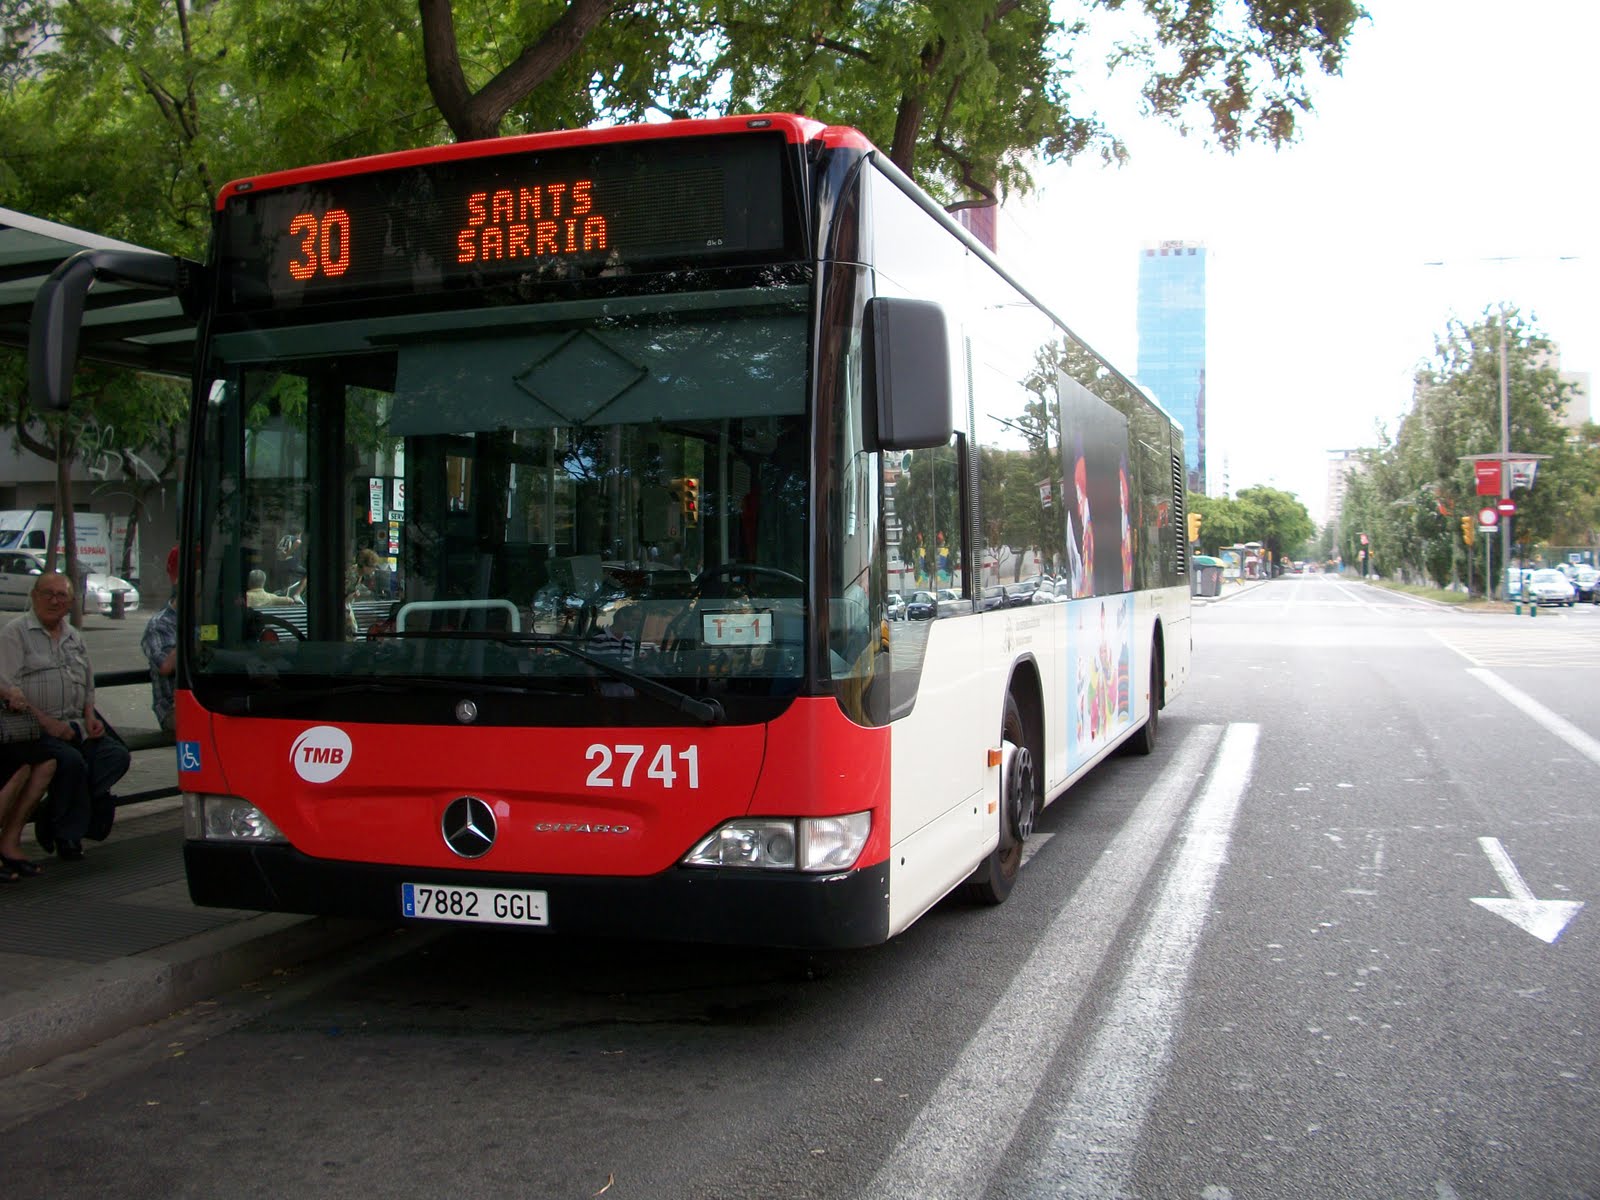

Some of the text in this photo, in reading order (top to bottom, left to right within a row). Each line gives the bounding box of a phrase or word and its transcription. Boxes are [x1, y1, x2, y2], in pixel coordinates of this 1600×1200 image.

[467, 180, 593, 226] SANTS
[289, 209, 351, 280] 30
[457, 216, 607, 263] SARRIA
[302, 747, 344, 764] TMB
[585, 743, 699, 788] 2741
[535, 822, 631, 834] CITARO
[419, 888, 479, 917] 7882
[494, 893, 541, 920] GGL
